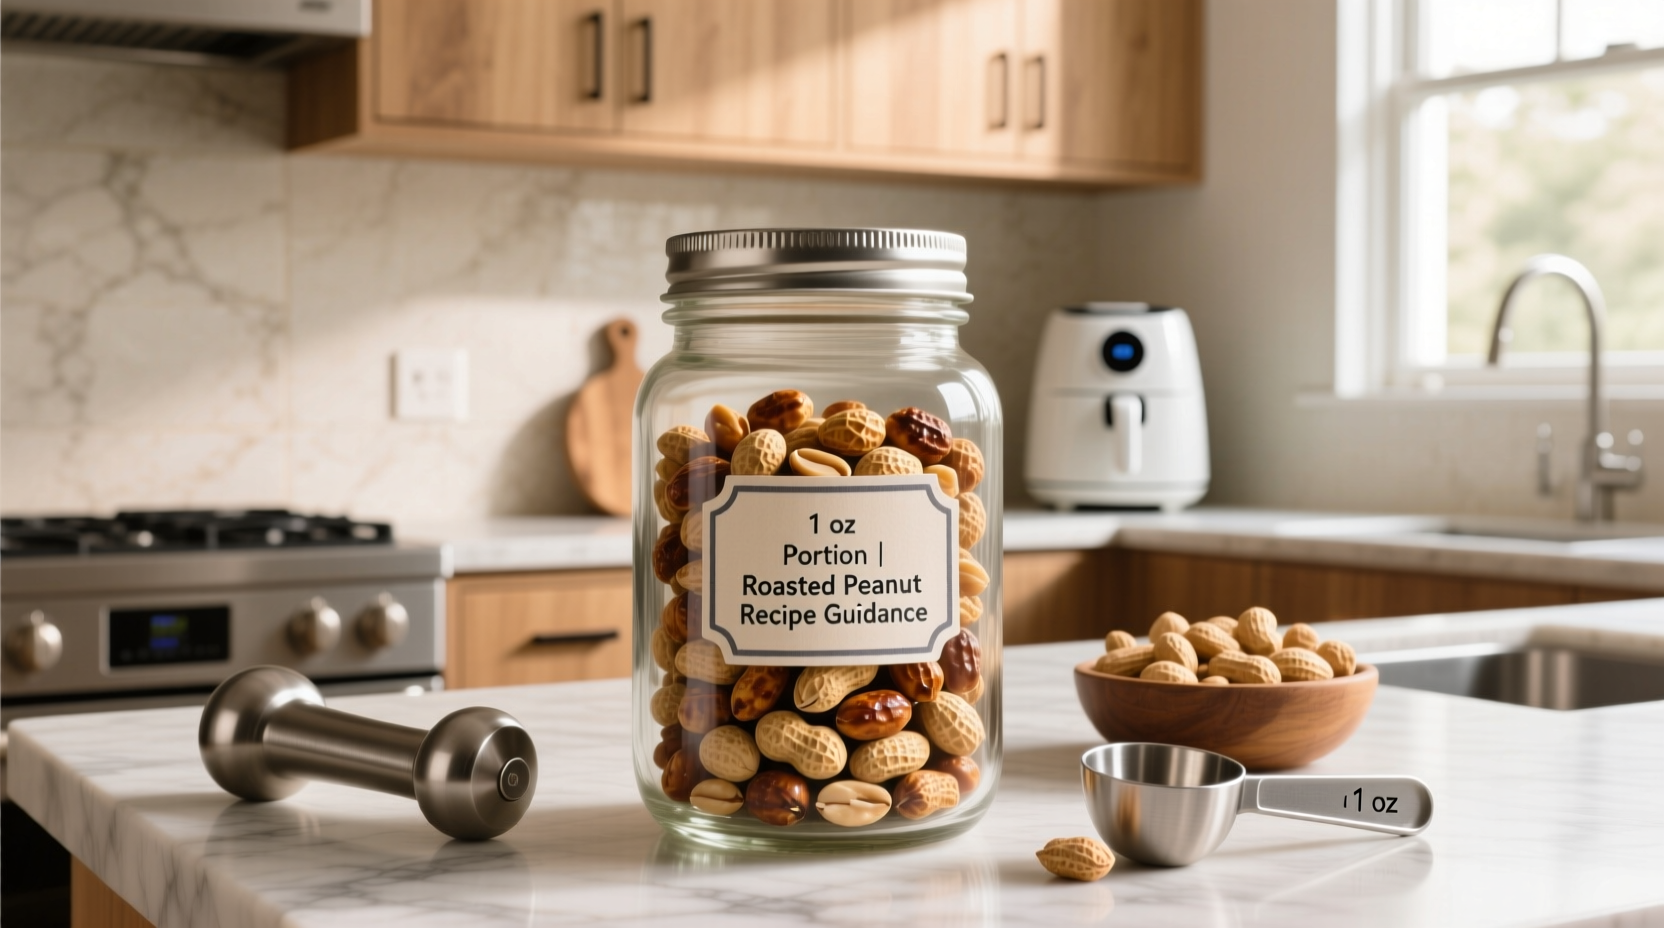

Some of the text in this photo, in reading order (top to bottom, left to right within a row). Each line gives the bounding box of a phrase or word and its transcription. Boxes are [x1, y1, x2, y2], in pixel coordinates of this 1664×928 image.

[808, 512, 856, 535] 1 oz
[783, 544, 867, 566] Portion
[742, 573, 922, 596] Roasted Peanut
[740, 601, 928, 631] Recipe Guidance
[1371, 796, 1399, 814] oz
